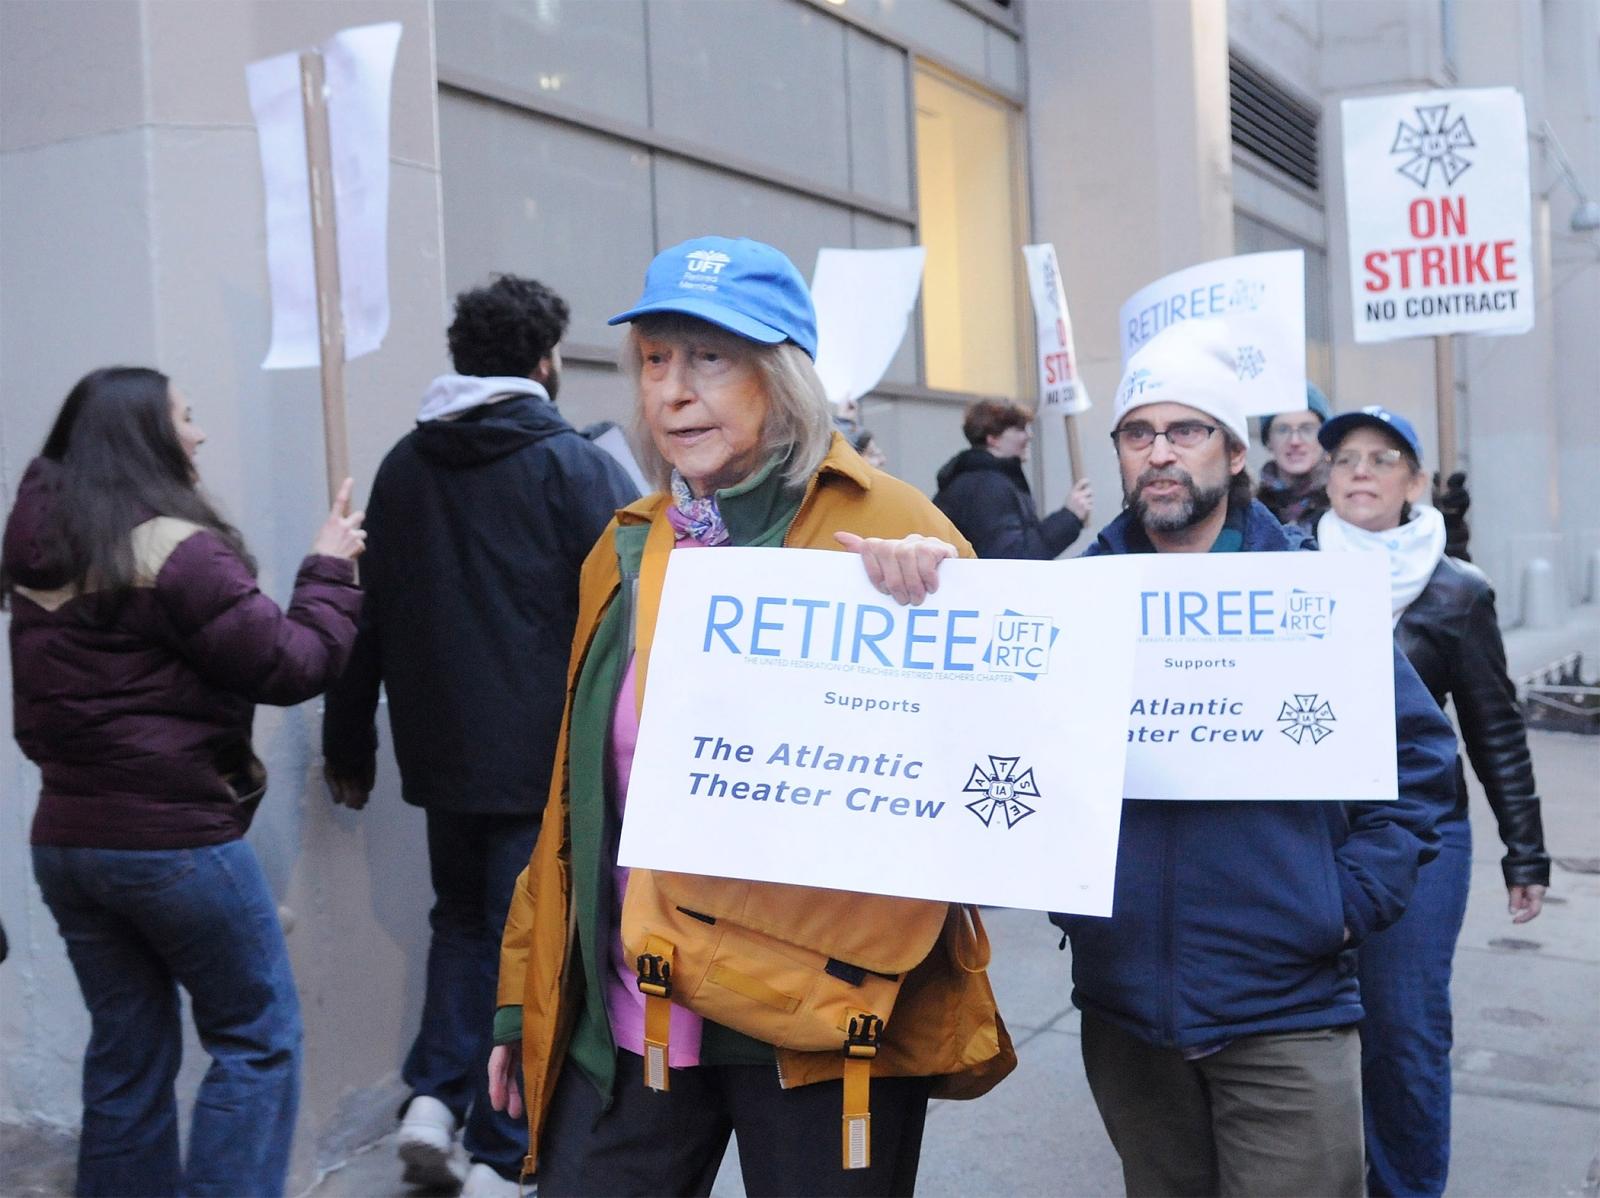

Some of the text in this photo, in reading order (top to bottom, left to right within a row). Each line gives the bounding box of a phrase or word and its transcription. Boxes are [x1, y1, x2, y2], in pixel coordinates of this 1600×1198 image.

[1409, 195, 1467, 239] ON
[688, 260, 726, 274] UFT
[1364, 240, 1517, 292] STRIKE
[1127, 283, 1225, 347] RETIREE
[1366, 288, 1519, 322] NO CONTRACT
[1140, 590, 1275, 636] TIREE
[1290, 596, 1325, 613] UFT
[703, 595, 980, 672] RETIREE
[998, 621, 1045, 644] UFT
[1291, 614, 1327, 631] RTC
[996, 645, 1044, 668] RTC
[1164, 657, 1237, 670] Supports
[823, 691, 922, 714] Supports
[1130, 698, 1244, 716] Atlantic
[1191, 725, 1264, 743] Crew
[693, 736, 923, 780] The Atlantic
[688, 772, 946, 819] Theater Crew
